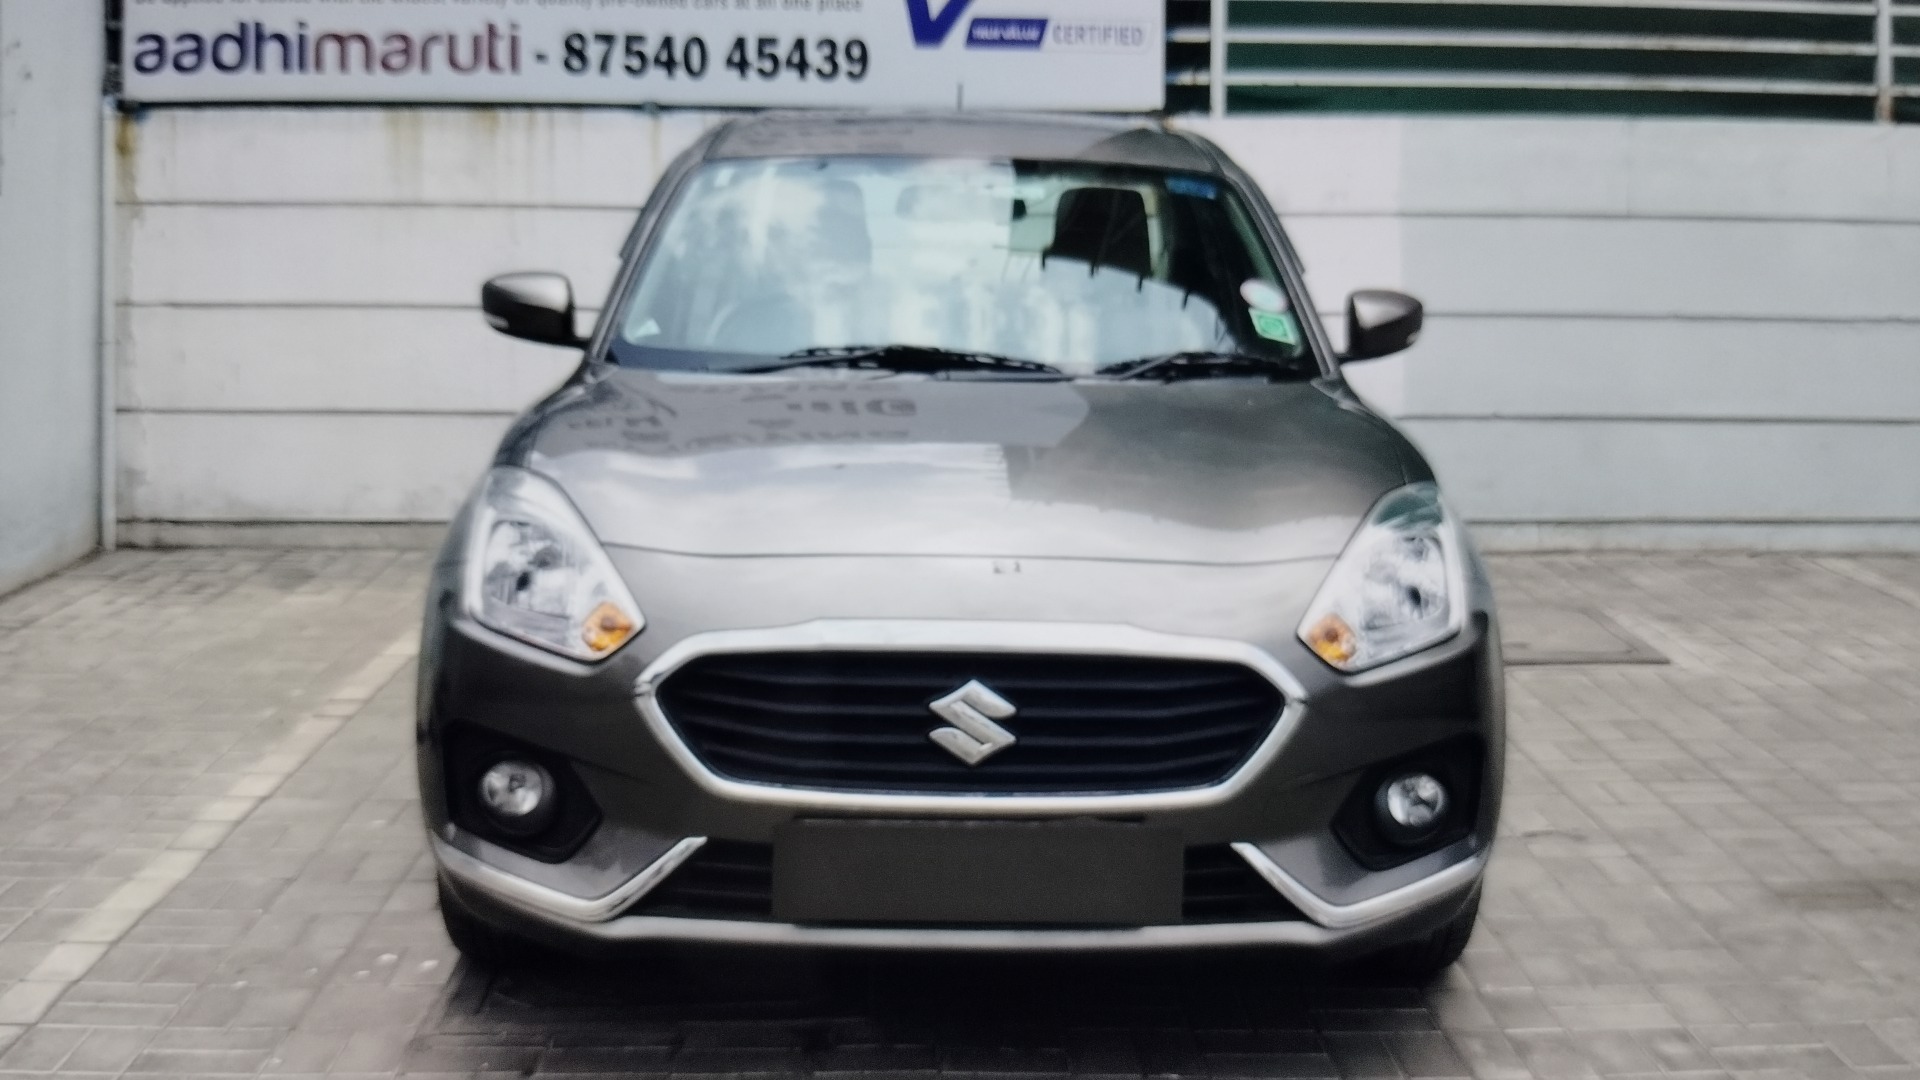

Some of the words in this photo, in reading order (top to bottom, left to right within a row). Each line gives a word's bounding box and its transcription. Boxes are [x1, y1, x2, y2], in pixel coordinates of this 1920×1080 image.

[134, 22, 523, 75] aadhimaruti
[562, 32, 709, 79] 87540
[725, 36, 870, 81] 45439
[1052, 23, 1144, 47] CERTIFIED
